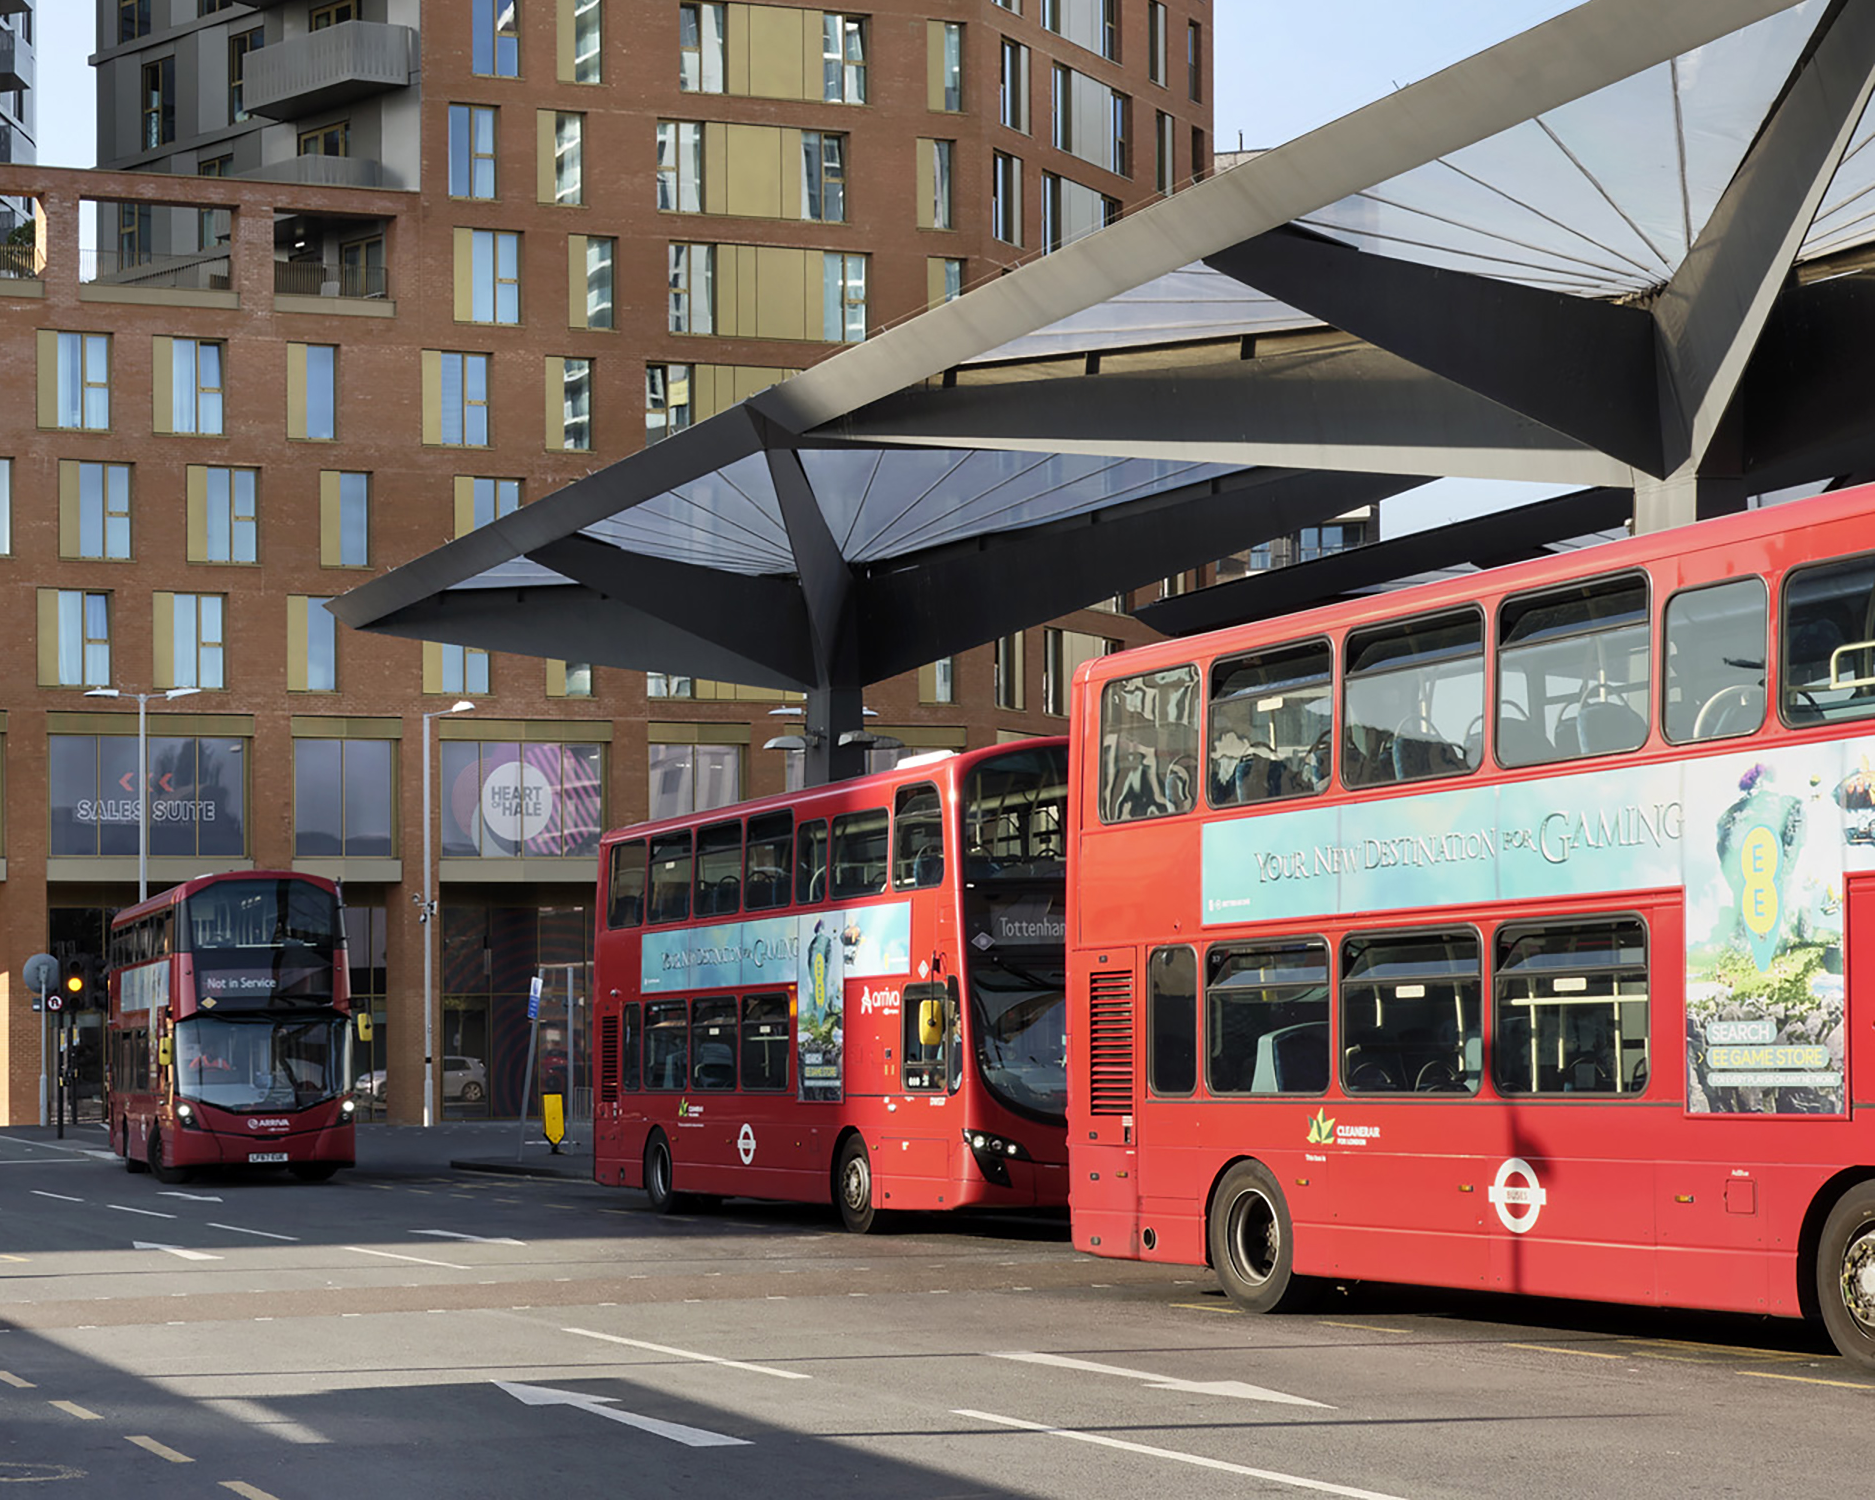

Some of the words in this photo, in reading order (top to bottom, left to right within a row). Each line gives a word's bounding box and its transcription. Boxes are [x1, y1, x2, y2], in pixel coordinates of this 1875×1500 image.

[491, 786, 542, 801] HEART
[152, 800, 215, 821] SUITE
[502, 802, 542, 816] HALE
[1254, 851, 1310, 883] YOUR
[1314, 846, 1362, 877] NEW
[1363, 828, 1496, 869] DESTINATION
[1502, 829, 1538, 852] FOR
[1539, 802, 1684, 865] GAMING
[207, 978, 227, 989] Not
[229, 978, 238, 988] in
[240, 977, 277, 988] Service
[1712, 1024, 1770, 1041] SEARCH
[1713, 1050, 1728, 1066] EE
[1730, 1049, 1773, 1066] GAME
[1776, 1049, 1822, 1066] STORE
[259, 1119, 290, 1127] ARRIVA
